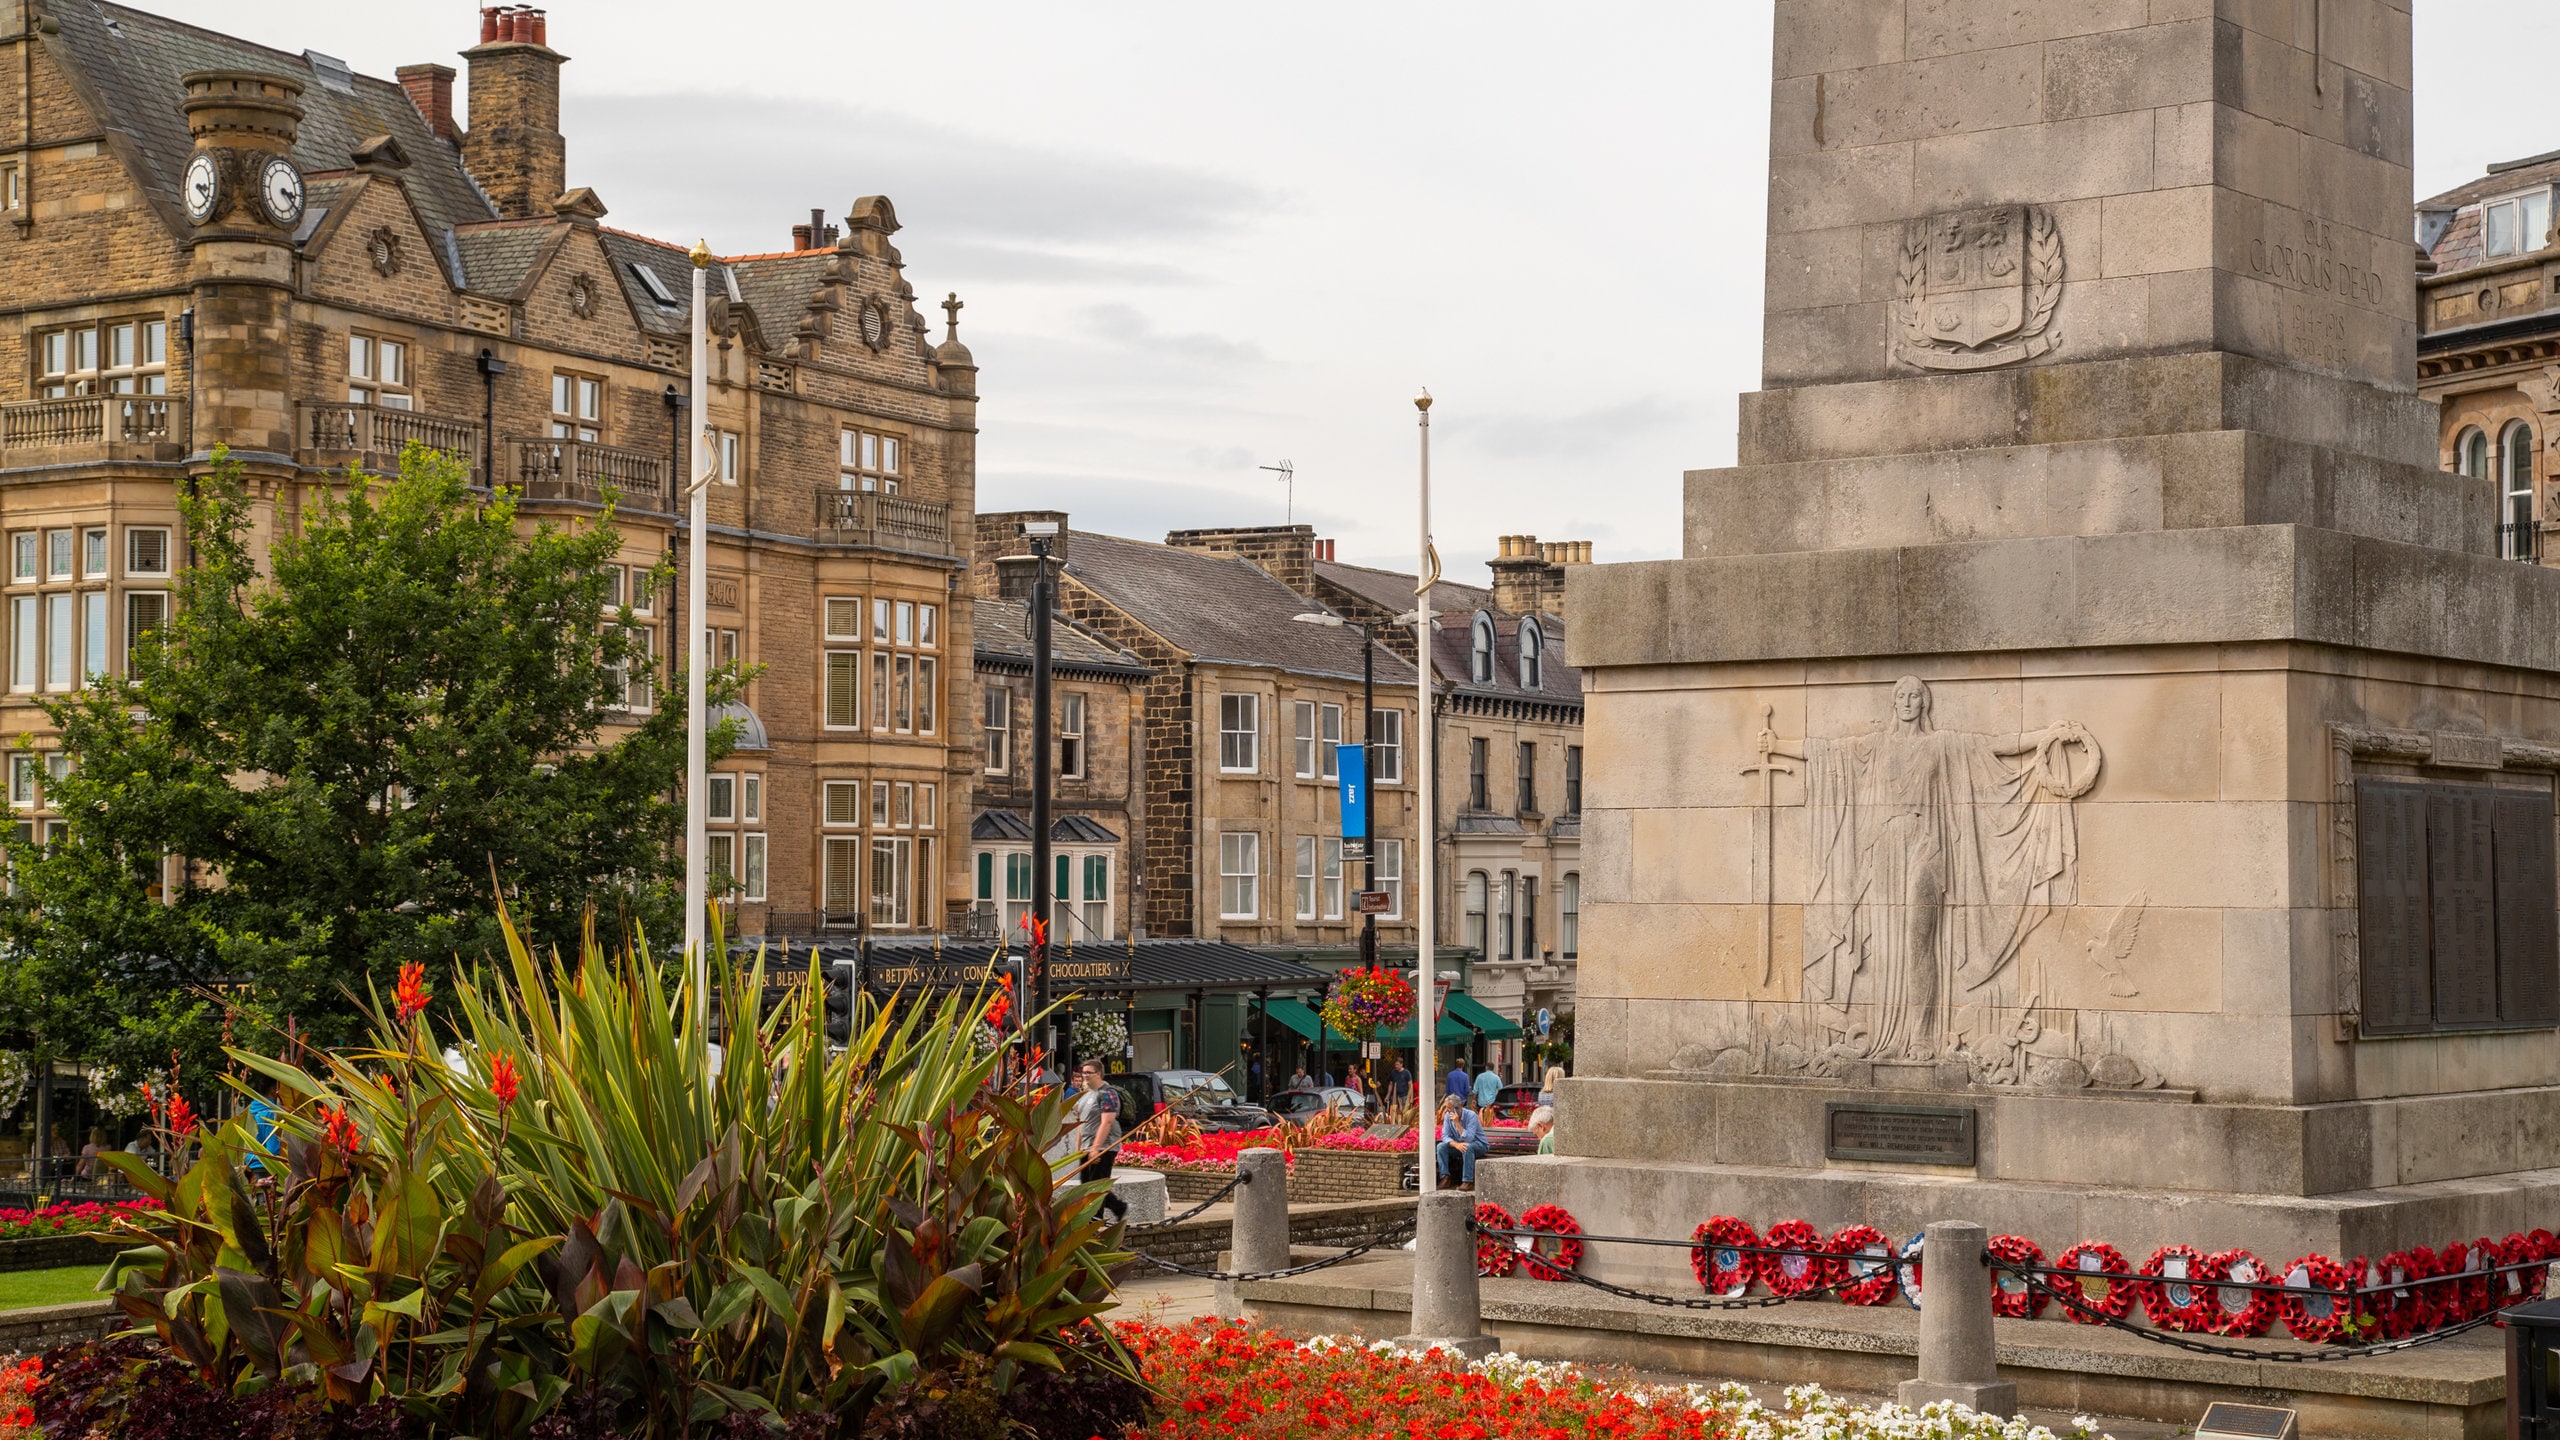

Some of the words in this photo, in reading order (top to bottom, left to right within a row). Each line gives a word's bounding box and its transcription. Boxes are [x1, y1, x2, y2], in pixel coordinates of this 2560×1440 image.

[2304, 220, 2332, 251] OUR
[2250, 238, 2332, 292] GLORIOUS
[2339, 262, 2383, 305] DEAD
[1348, 783, 1356, 805] Jazz
[885, 968, 919, 983] BETTYS
[1049, 962, 1111, 978] CHOCOLATIERS
[1888, 1143, 1921, 1151] REMEMBER
